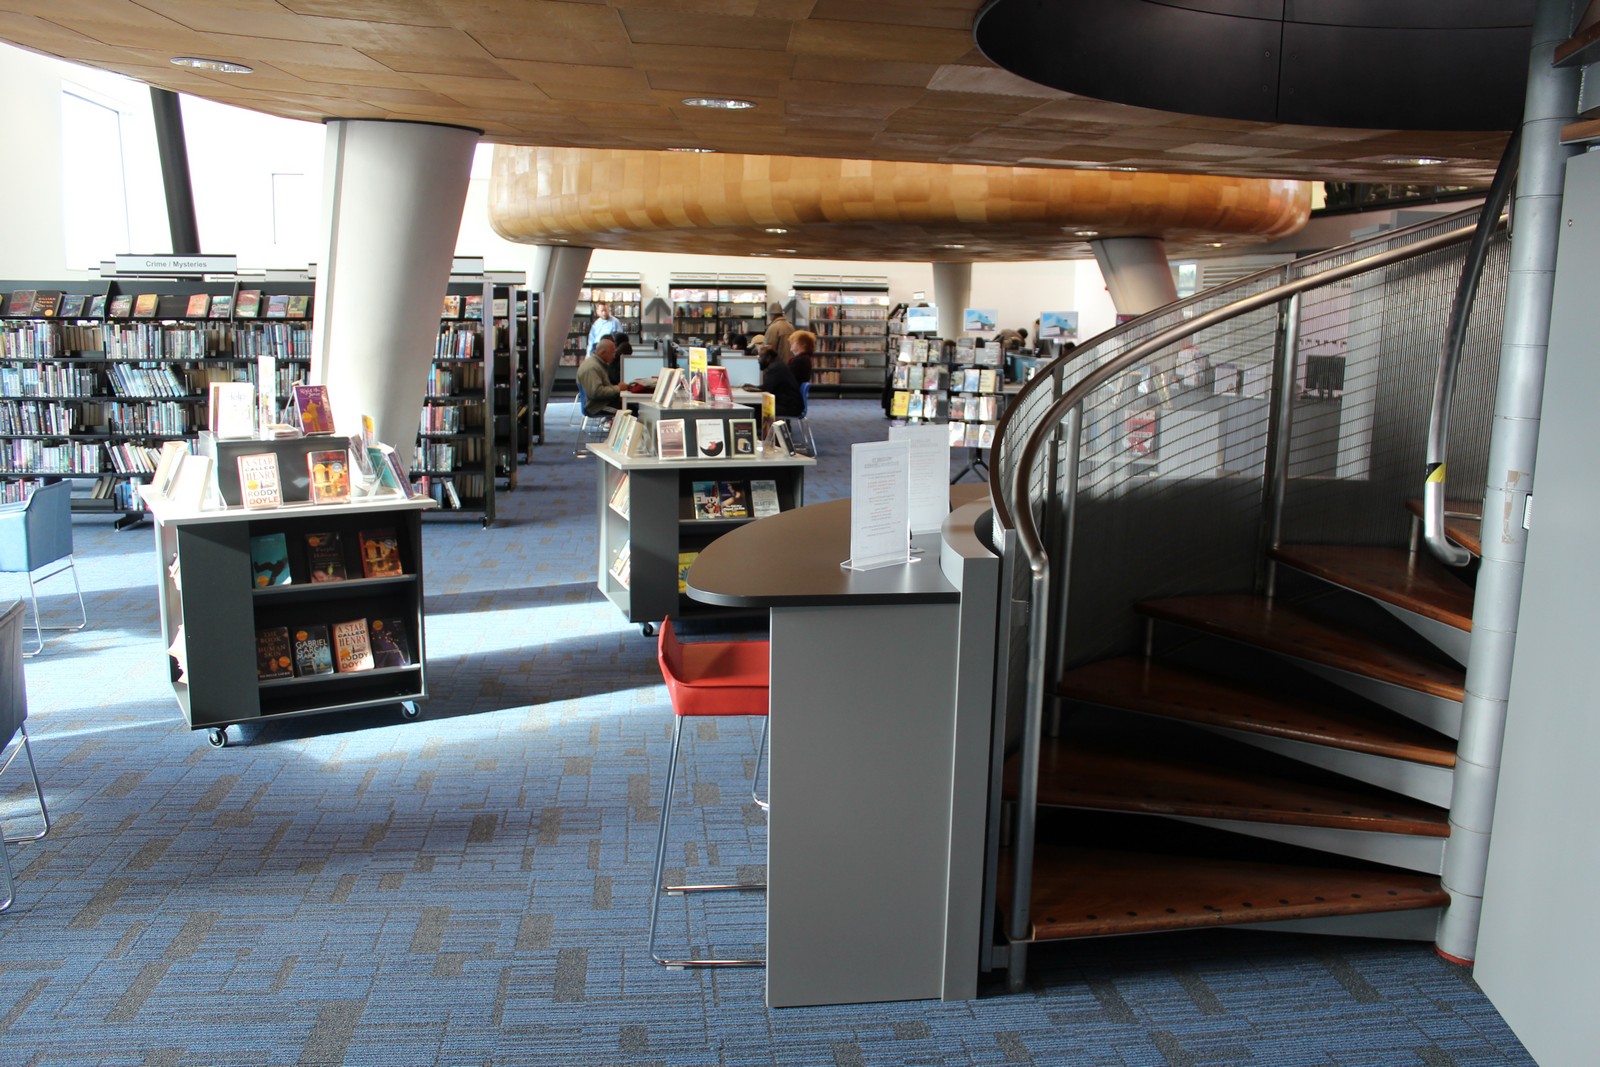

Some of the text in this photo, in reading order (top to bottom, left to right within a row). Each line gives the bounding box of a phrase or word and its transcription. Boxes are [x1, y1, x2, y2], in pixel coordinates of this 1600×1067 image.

[145, 260, 167, 268] Crime
[172, 260, 207, 269] Mysteries
[253, 457, 273, 466] STAR
[246, 470, 276, 481] HENRY
[248, 488, 278, 498] RODDY
[249, 496, 279, 505] DOYLE
[344, 623, 364, 632] STAR
[338, 630, 366, 638] CALLED
[295, 638, 328, 648] GABRIEL
[339, 634, 367, 647] HENRY
[341, 652, 369, 662] RODDY
